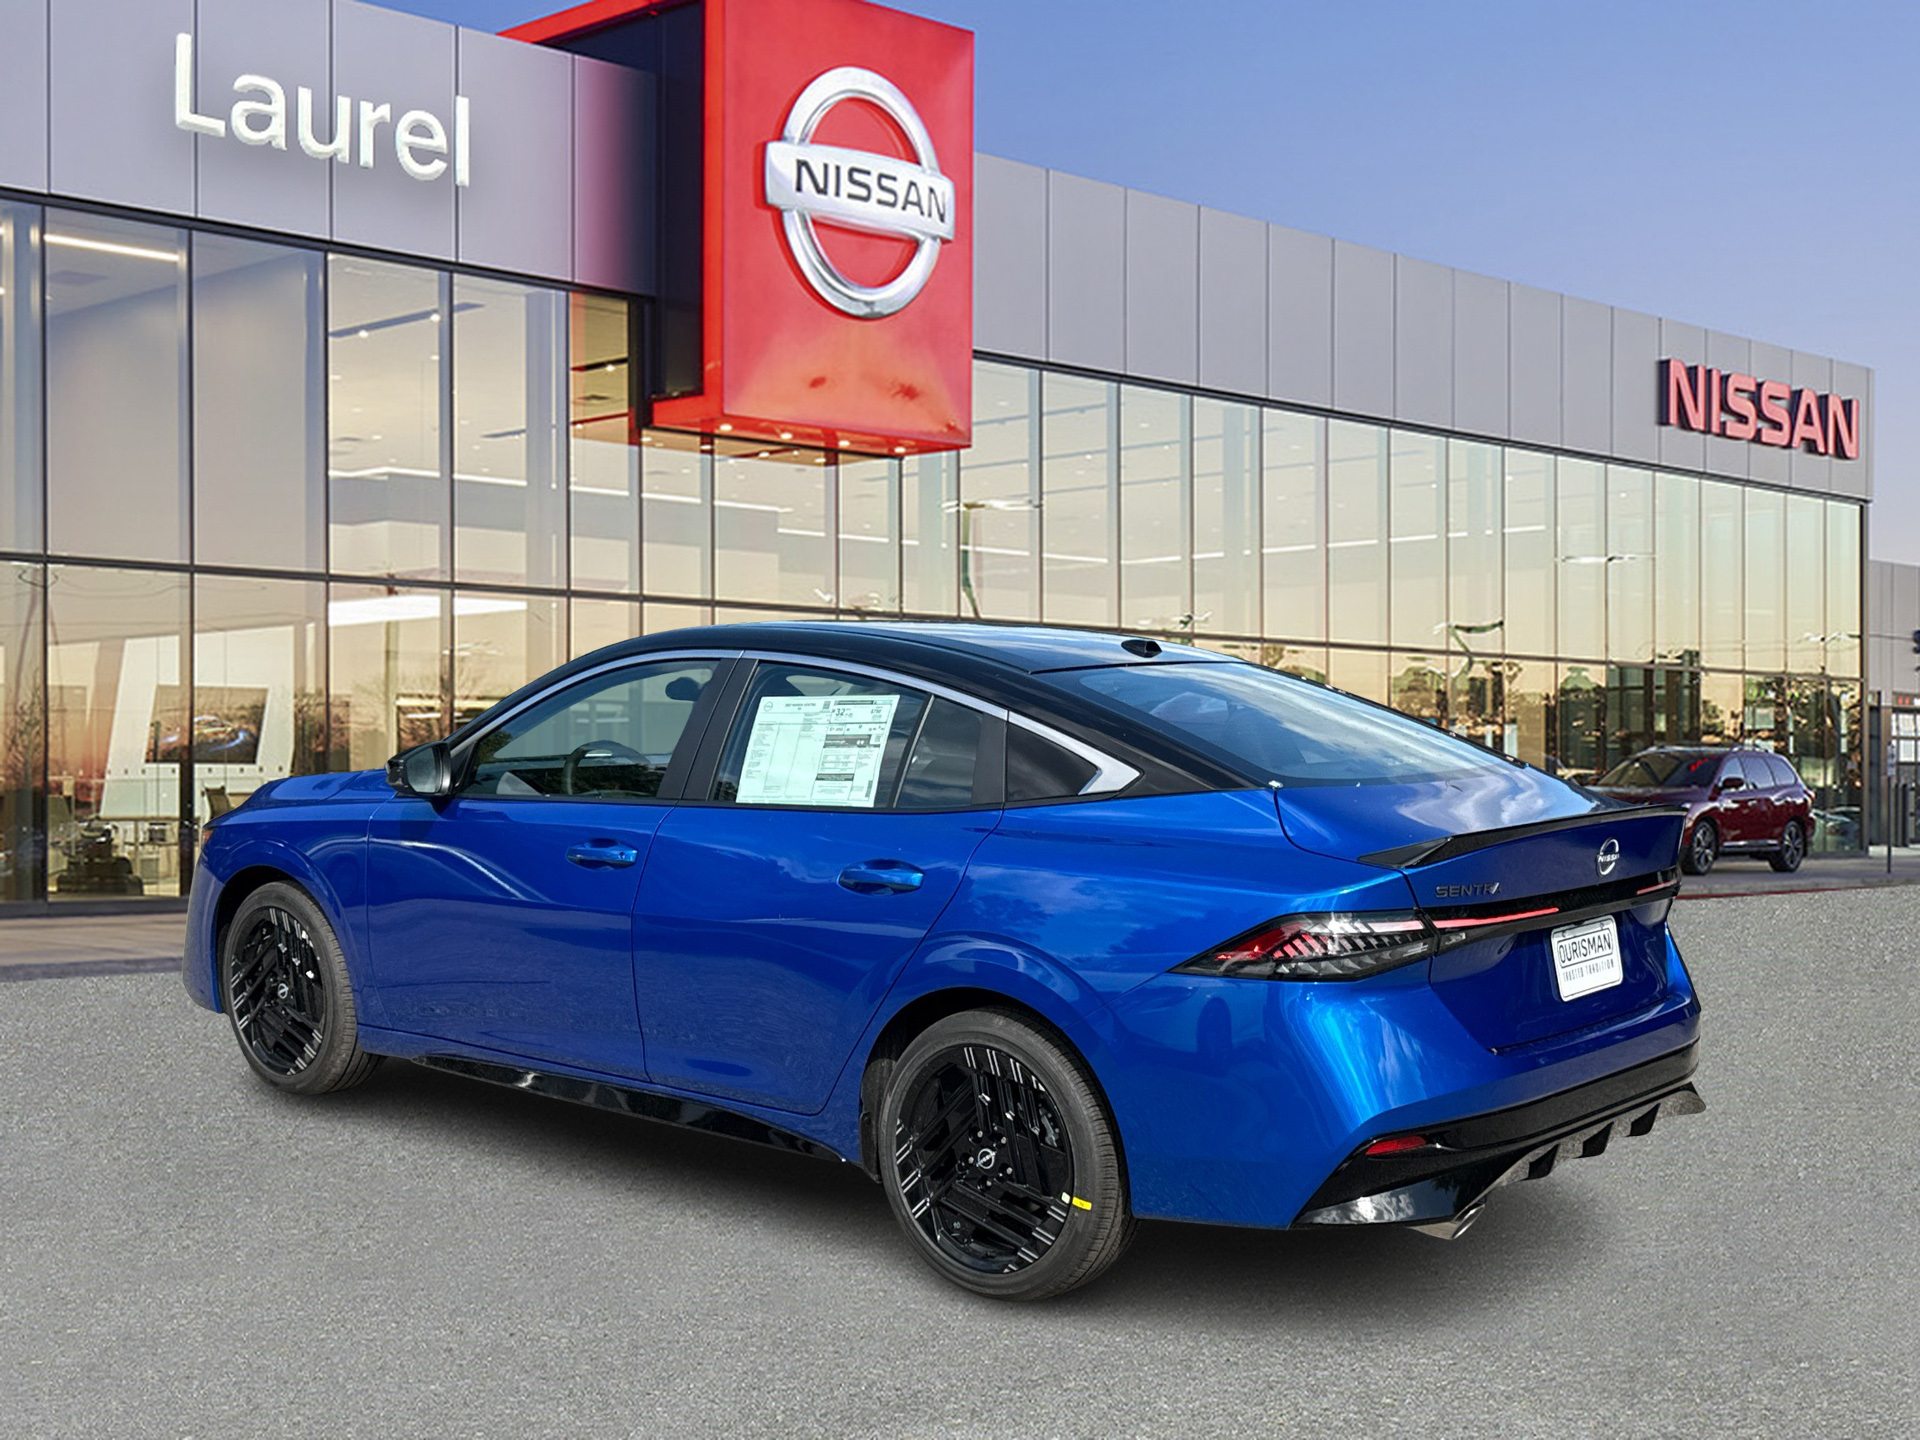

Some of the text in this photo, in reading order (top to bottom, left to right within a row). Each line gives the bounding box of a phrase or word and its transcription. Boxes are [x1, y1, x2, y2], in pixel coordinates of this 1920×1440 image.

[175, 32, 470, 188] Laurel
[795, 158, 946, 224] NISSAN
[1658, 358, 1860, 460] NISSAN
[1559, 933, 1611, 963] OURISMAN
